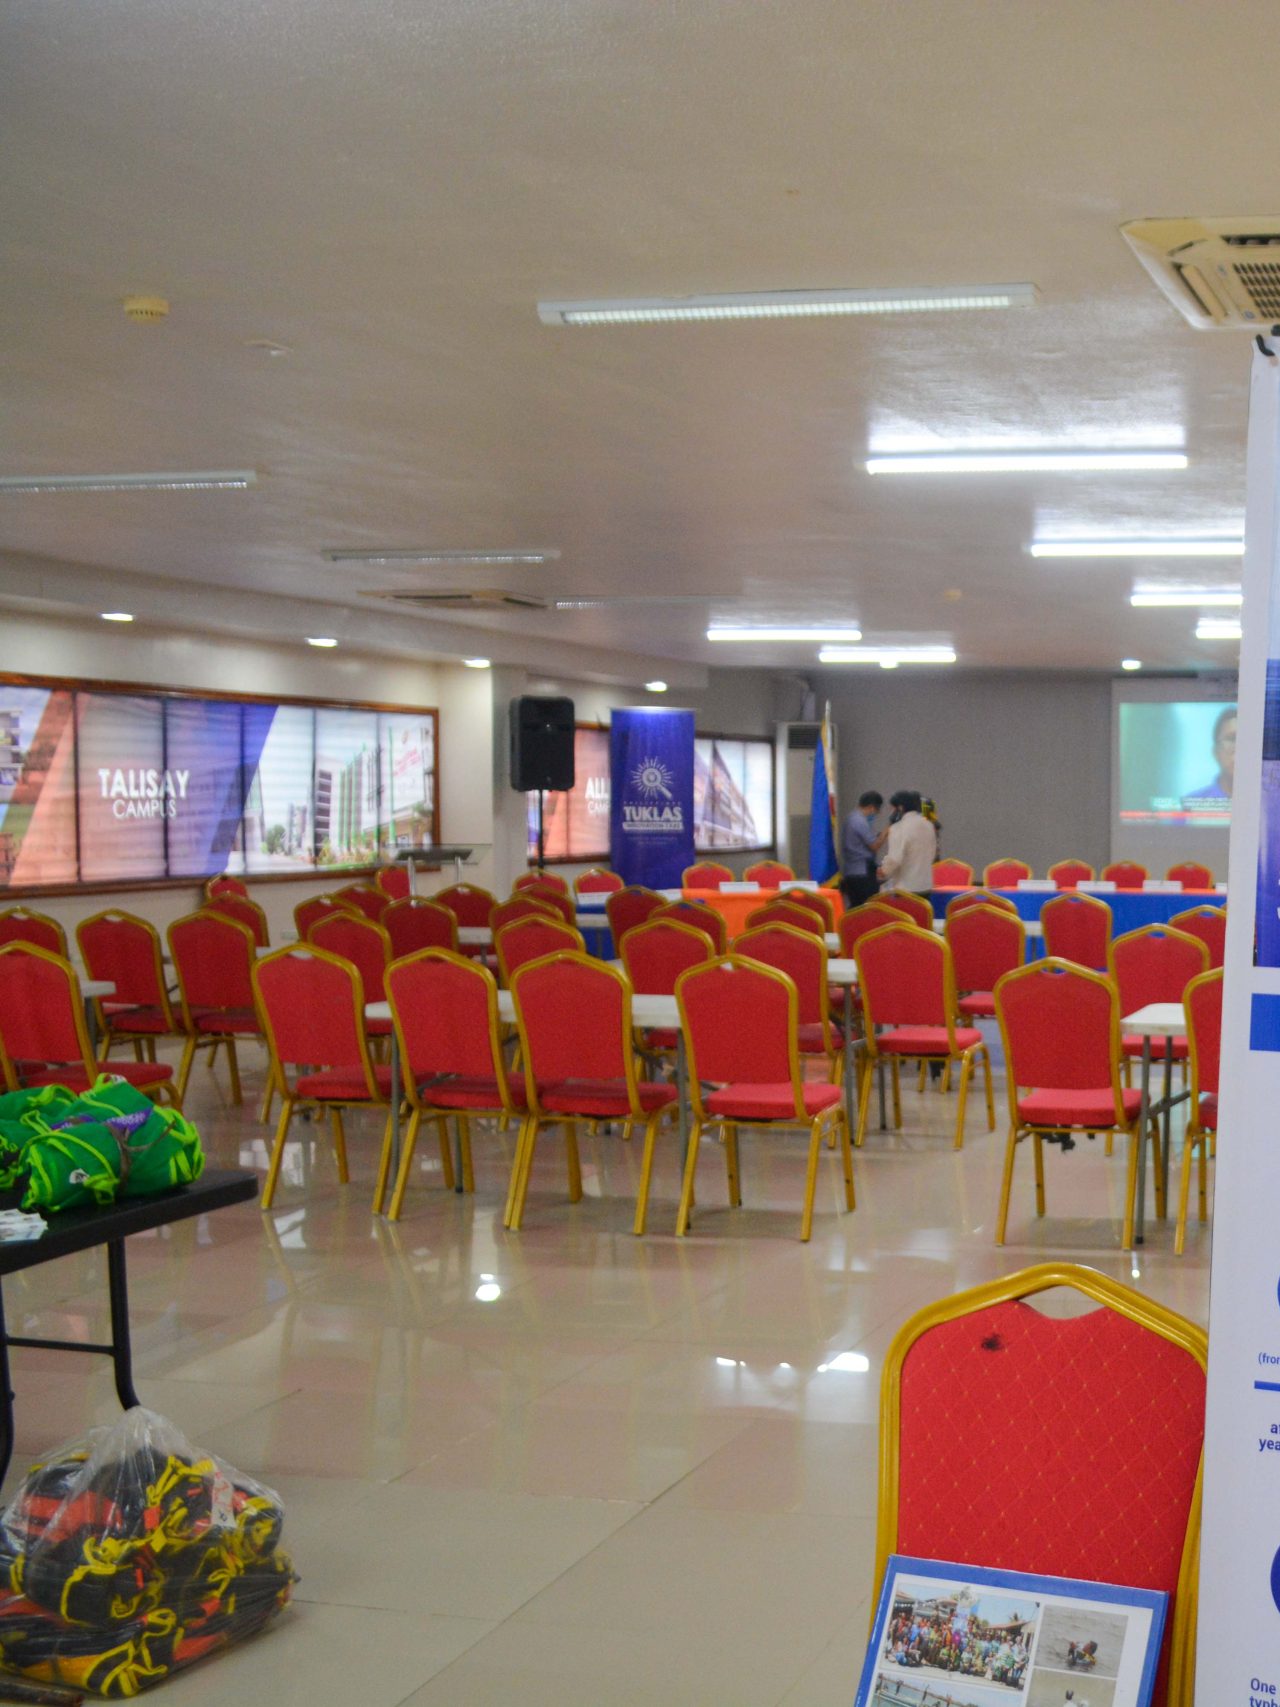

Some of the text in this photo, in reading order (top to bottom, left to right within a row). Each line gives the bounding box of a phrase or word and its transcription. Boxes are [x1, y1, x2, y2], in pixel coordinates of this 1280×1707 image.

[98, 768, 190, 798] TALISAY
[623, 806, 682, 821] TUKLAS
[1250, 1678, 1276, 1695] One
